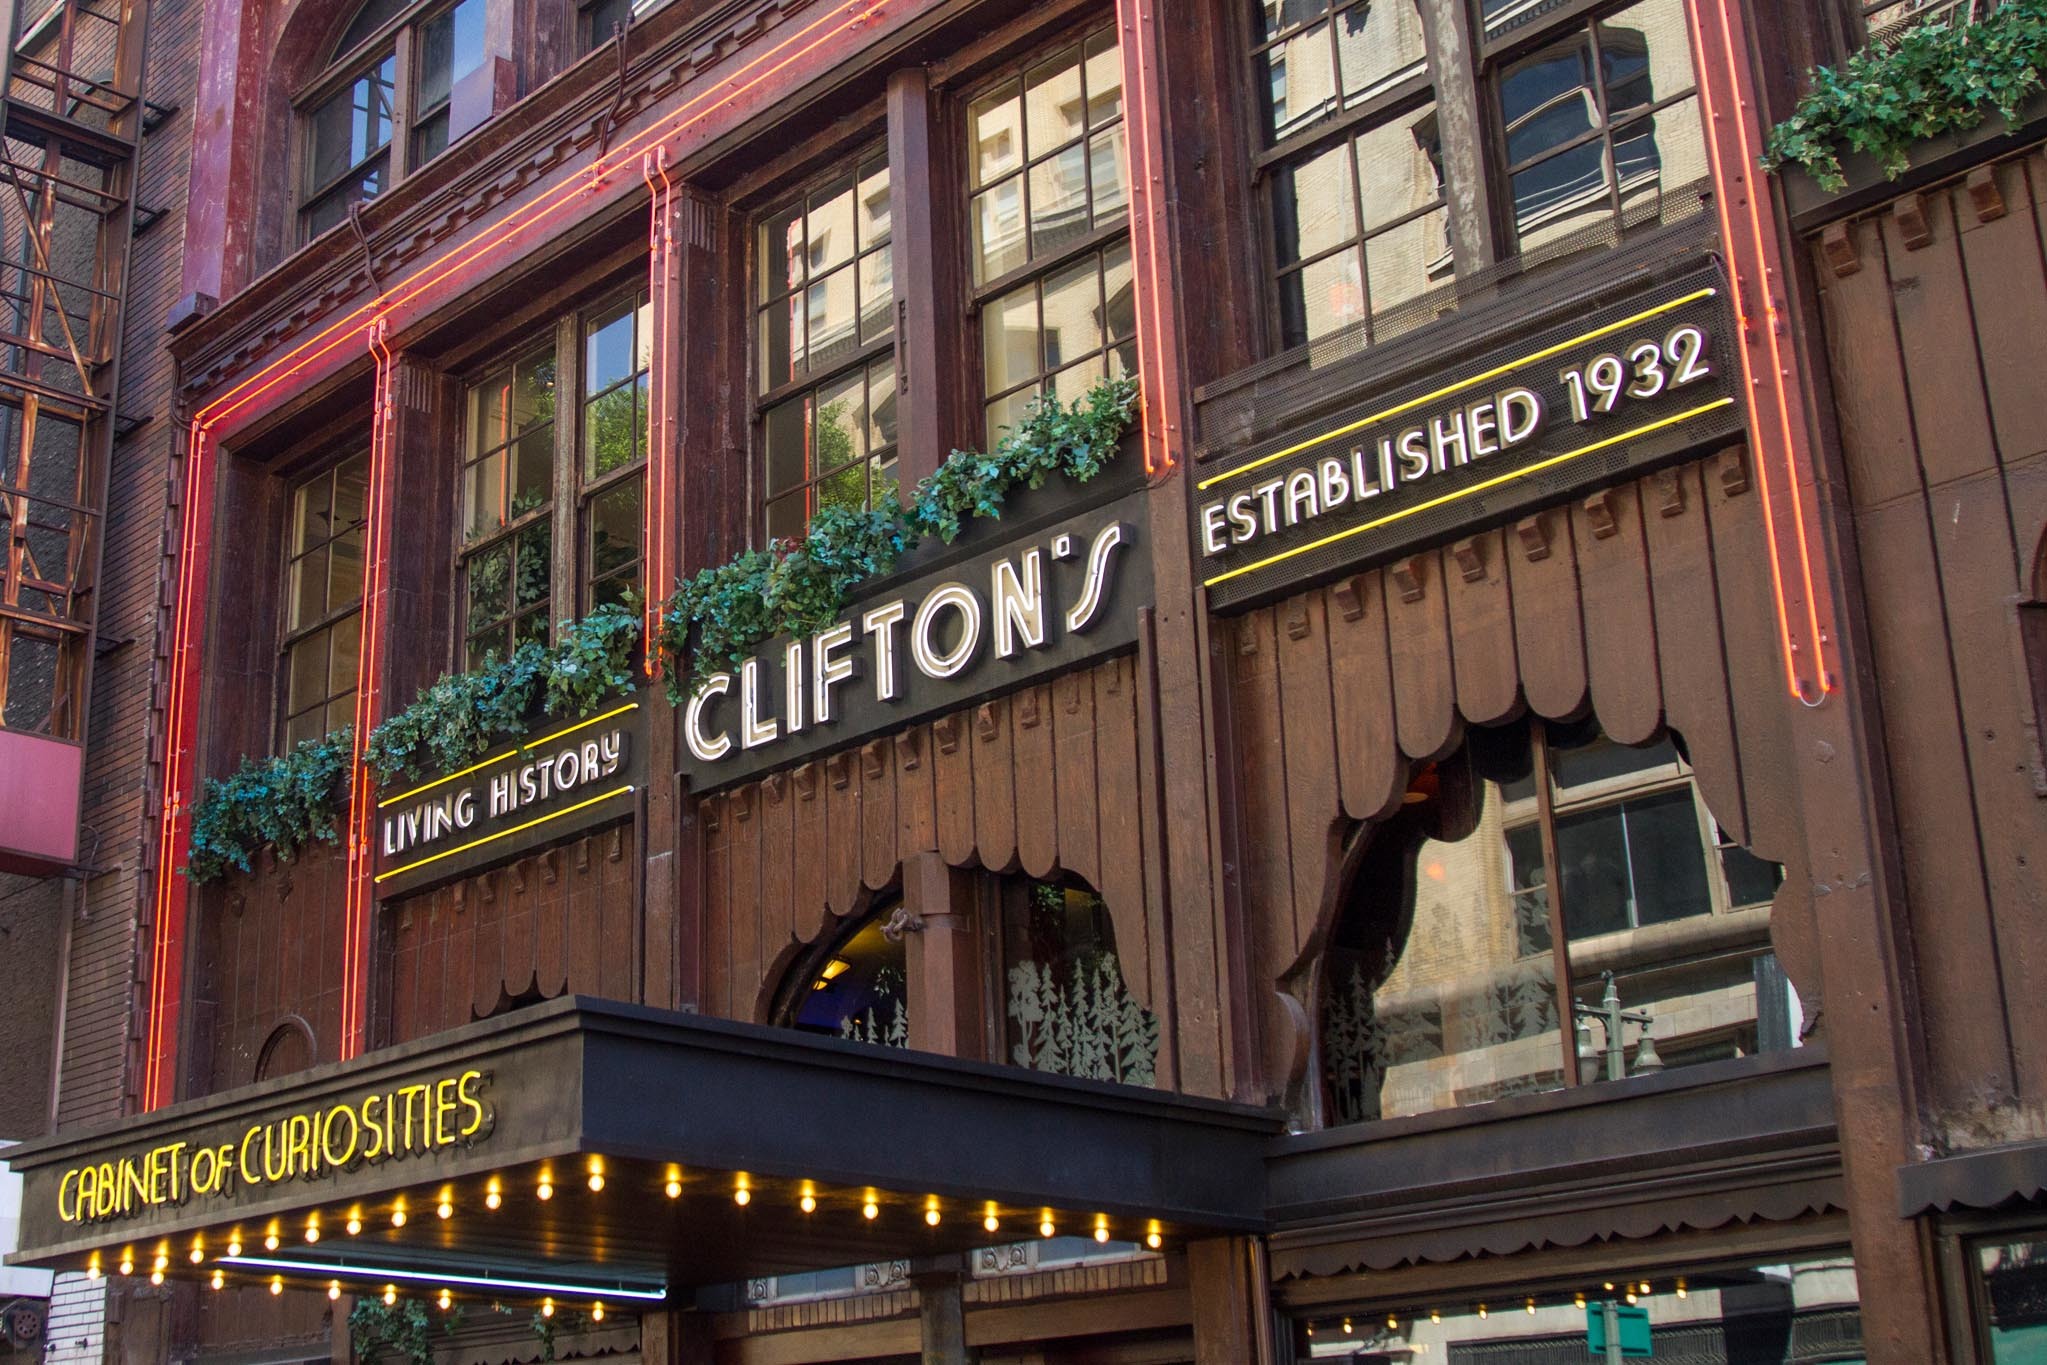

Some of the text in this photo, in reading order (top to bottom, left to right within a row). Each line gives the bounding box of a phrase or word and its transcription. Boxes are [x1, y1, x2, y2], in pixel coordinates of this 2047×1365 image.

[1201, 324, 1710, 557] ESTABLISHED 1932
[685, 521, 1125, 762] CLIFTON'S
[384, 729, 622, 857] LIVING HISTORY
[58, 1070, 482, 1222] CABINET OF CURIOSITIES
